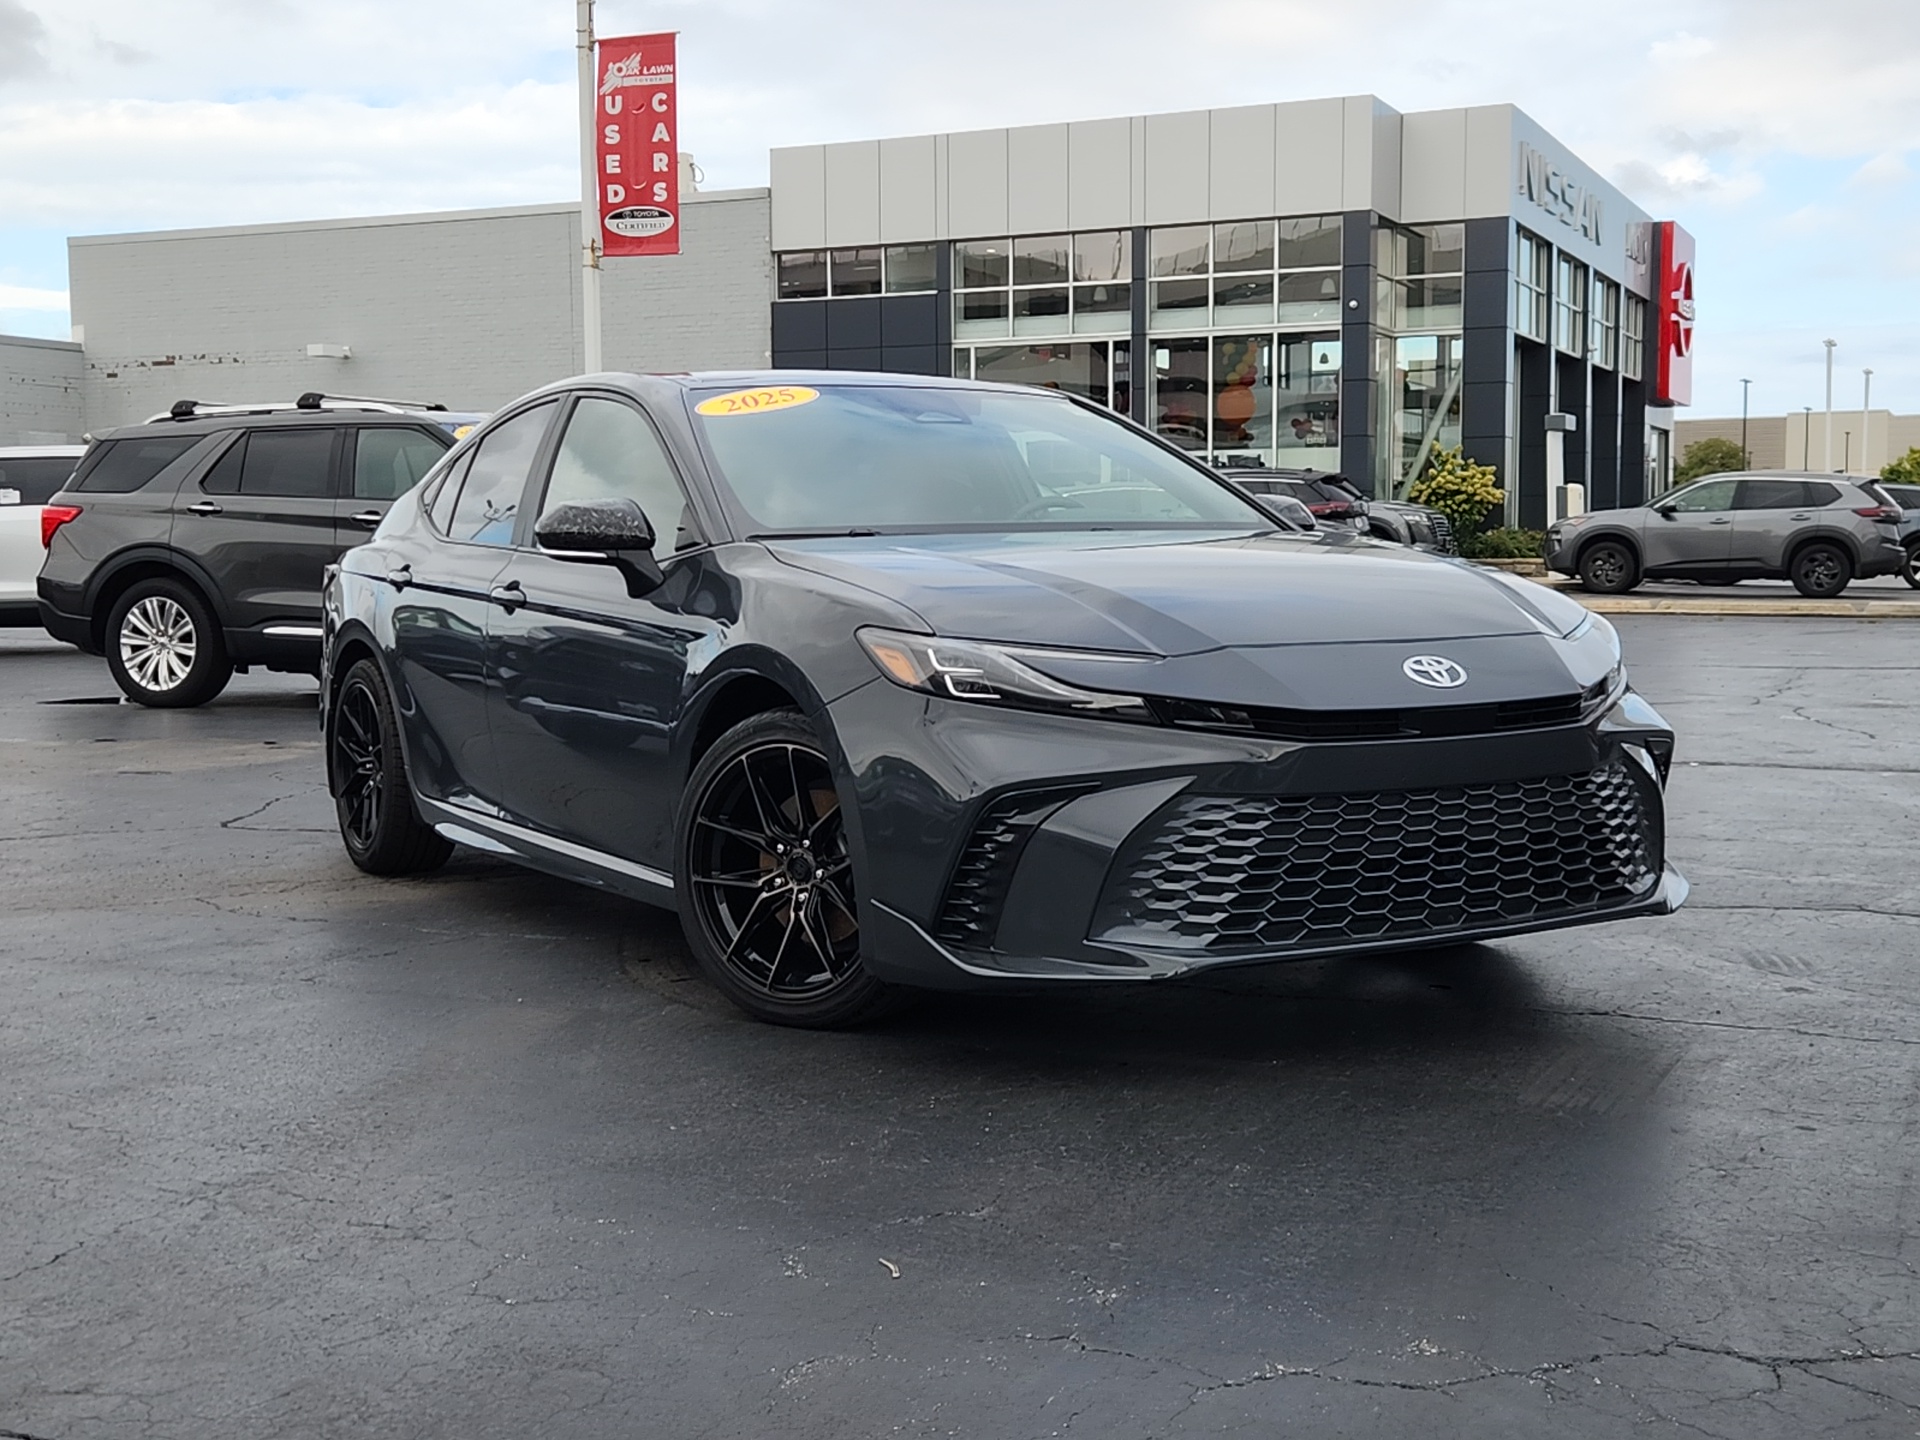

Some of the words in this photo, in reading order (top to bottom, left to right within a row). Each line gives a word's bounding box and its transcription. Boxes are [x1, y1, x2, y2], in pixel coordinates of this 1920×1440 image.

[612, 62, 641, 77] OAK
[642, 63, 674, 75] LAWN
[604, 95, 626, 204] USED
[651, 92, 671, 203] CARS
[1518, 142, 1604, 246] NISSAN
[721, 389, 796, 413] 2025
